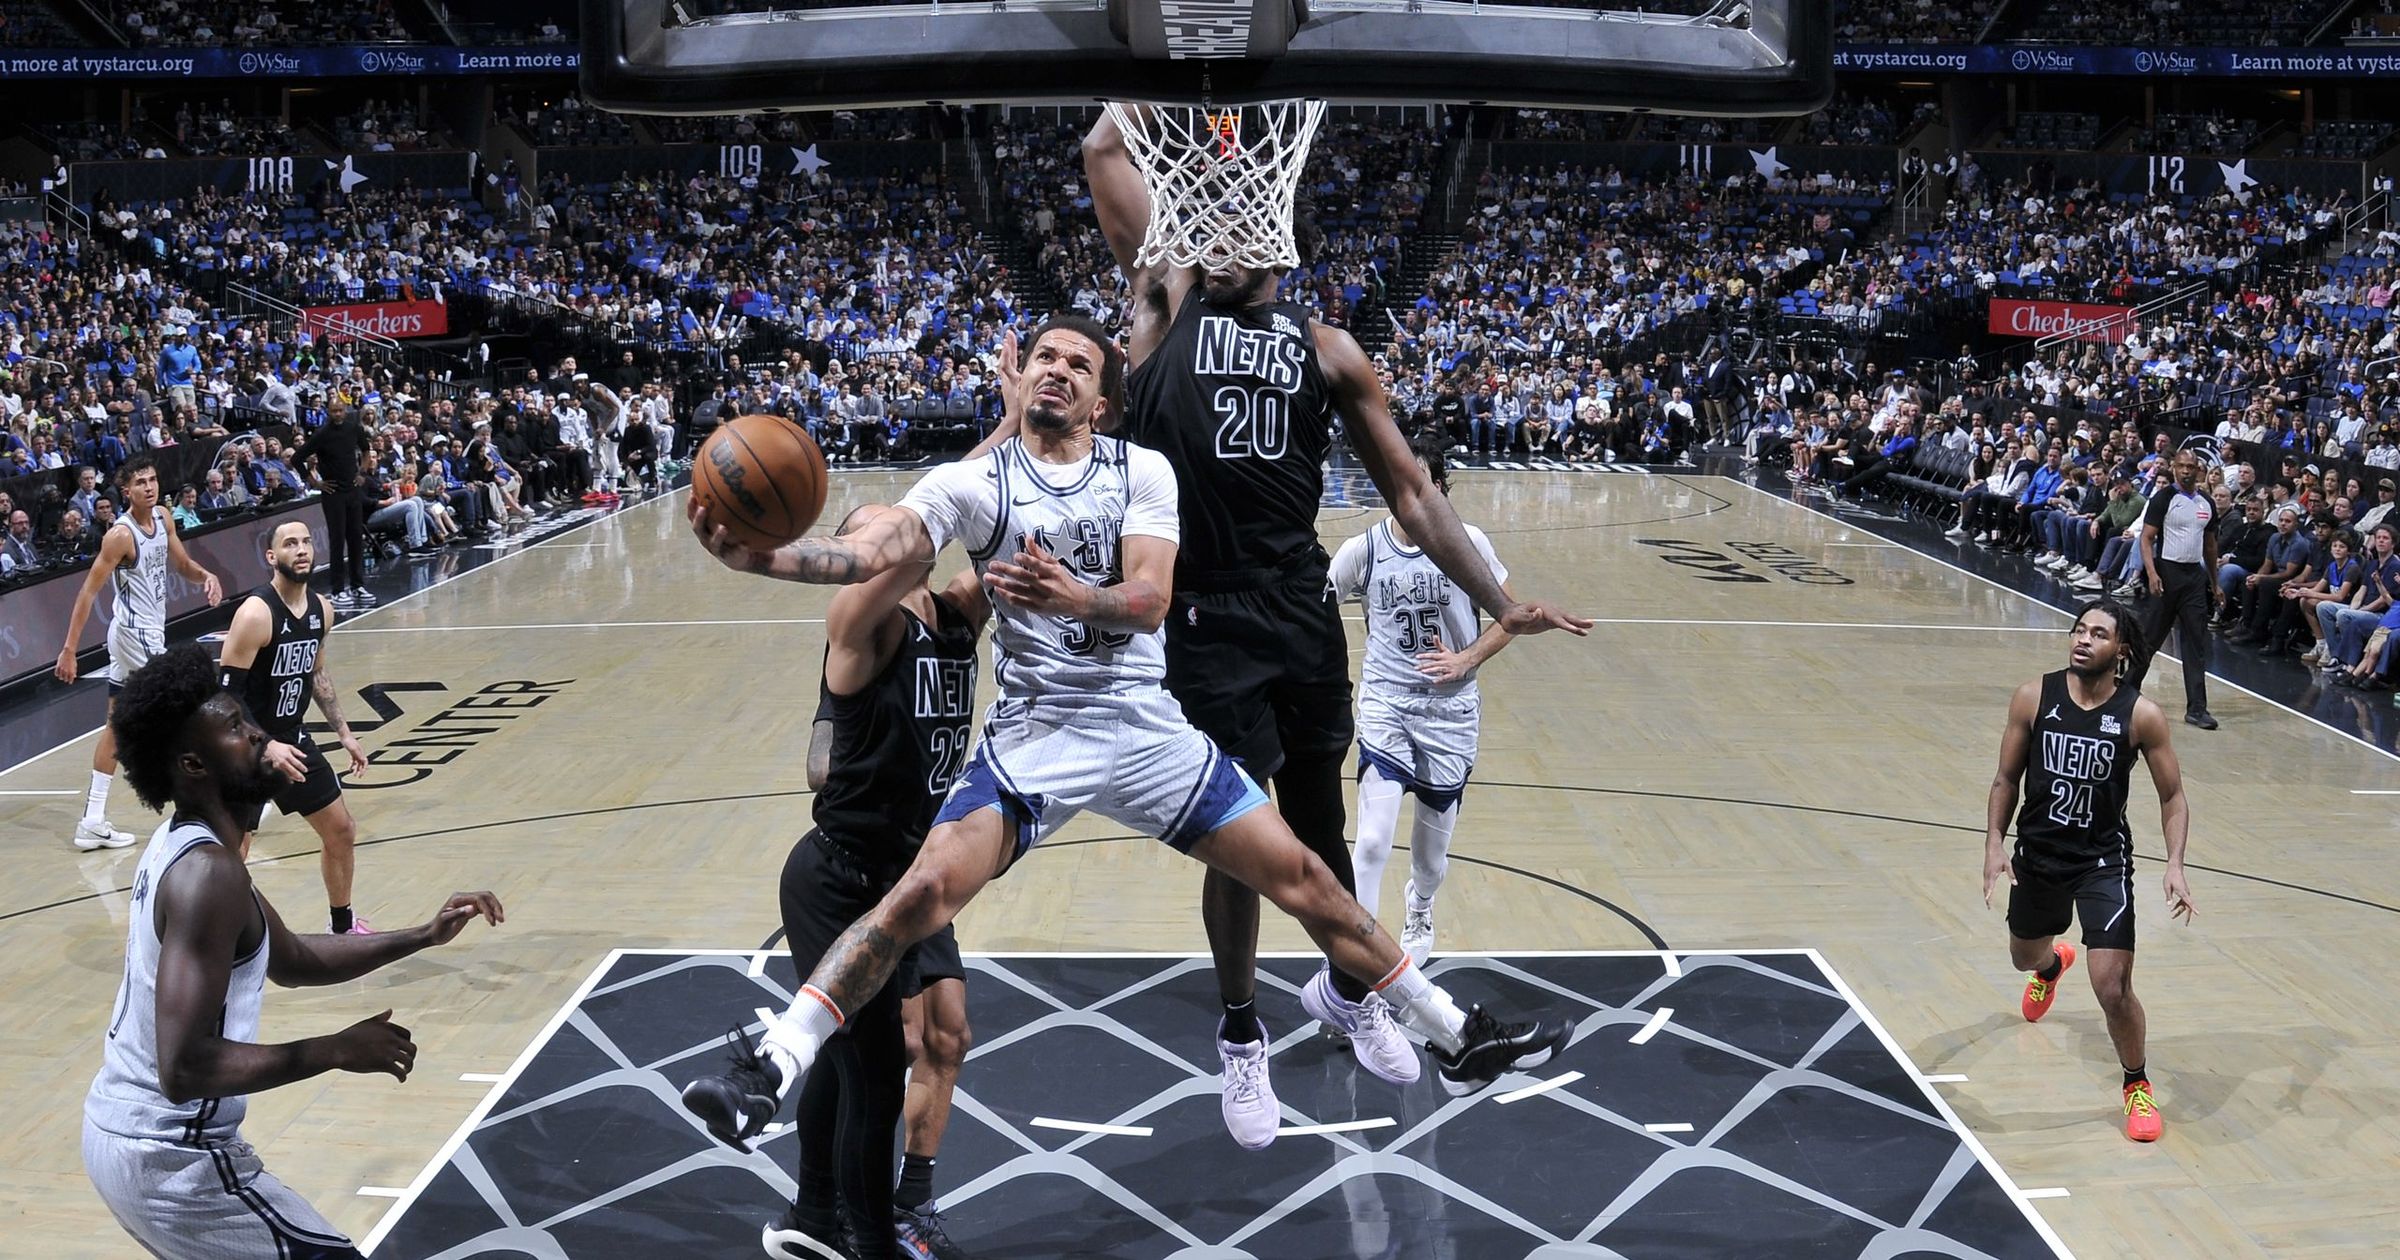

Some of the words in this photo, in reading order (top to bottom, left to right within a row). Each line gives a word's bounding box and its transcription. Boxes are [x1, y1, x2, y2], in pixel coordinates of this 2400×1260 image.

[12, 59, 58, 72] more
[63, 56, 78, 71] at
[83, 56, 194, 75] vystarcu.org
[257, 52, 300, 73] VyStar
[379, 51, 424, 72] VyStar
[458, 53, 510, 68] Learn
[515, 54, 562, 67] more
[1833, 52, 1849, 65] at
[1853, 51, 1968, 70] vystarcu.org
[2030, 50, 2074, 70] VyStar
[2152, 51, 2197, 72] VyStar
[2231, 54, 2283, 70] Learn
[2287, 56, 2333, 70] more
[2337, 54, 2353, 70] at
[249, 156, 293, 193] 108
[721, 144, 761, 178] 109
[325, 308, 422, 336] Checkers
[2012, 306, 2109, 337] Checkers
[1195, 316, 1306, 394] NETS
[1214, 385, 1290, 460] 20
[1724, 542, 1855, 585] CENTER
[1394, 607, 1443, 653] 35
[271, 638, 319, 677] NETS
[276, 677, 303, 718] 13
[336, 678, 578, 790] CENTER
[2043, 730, 2115, 781] NETS
[2048, 778, 2093, 828] 24
